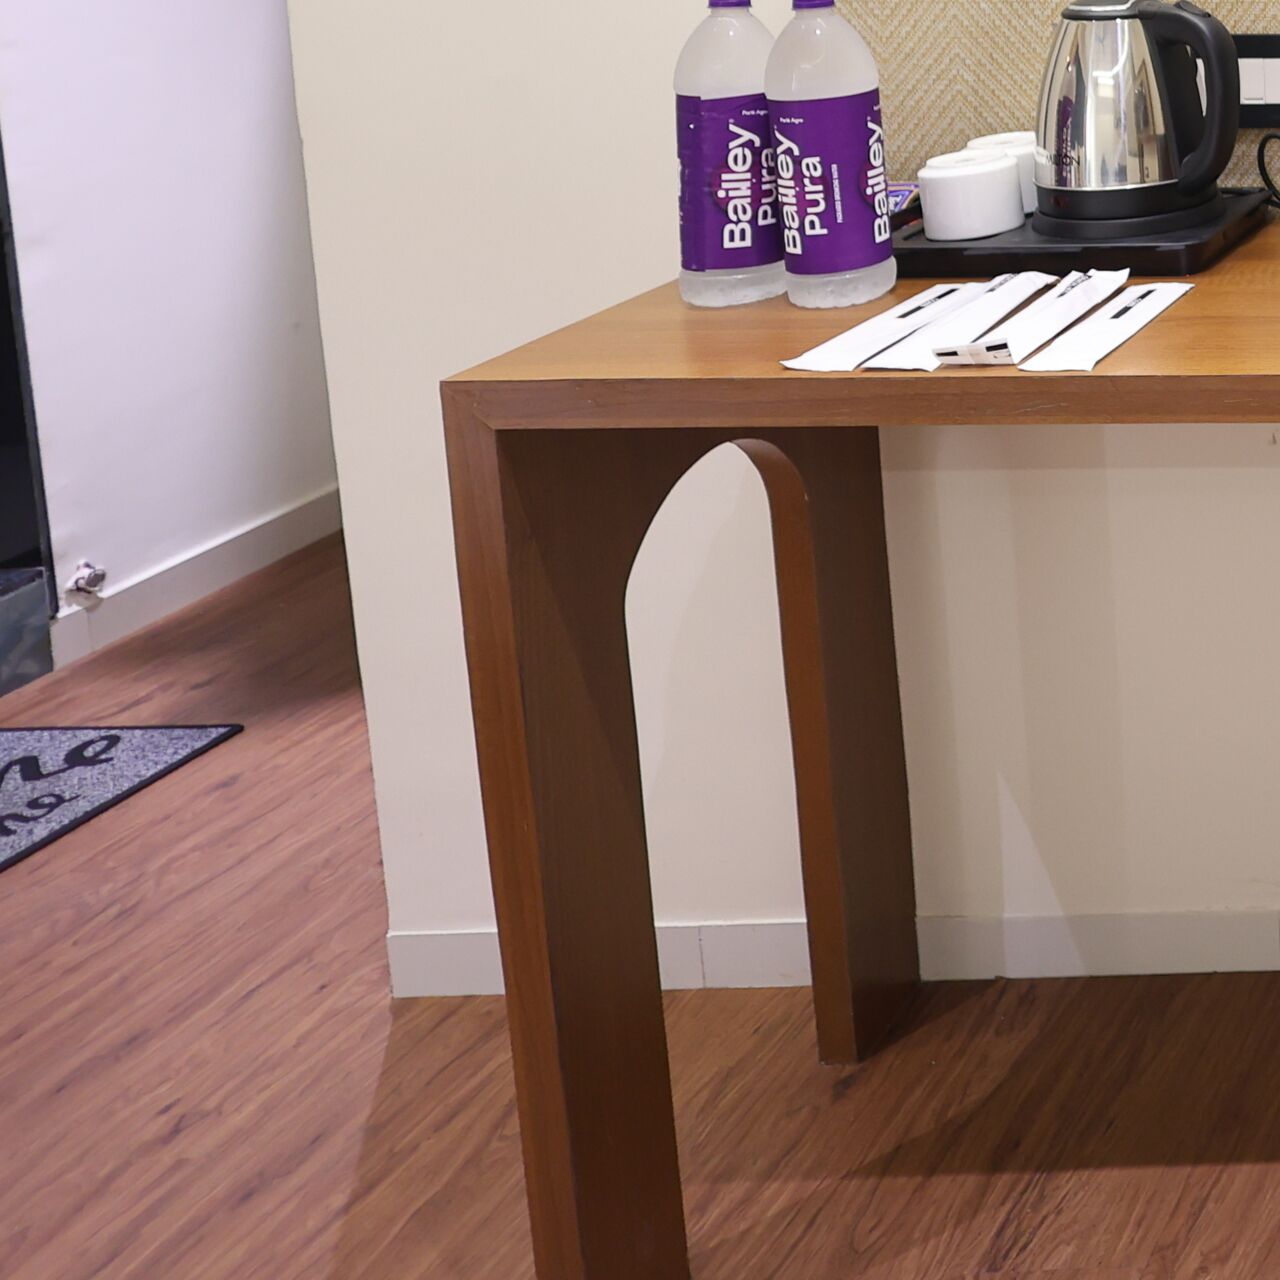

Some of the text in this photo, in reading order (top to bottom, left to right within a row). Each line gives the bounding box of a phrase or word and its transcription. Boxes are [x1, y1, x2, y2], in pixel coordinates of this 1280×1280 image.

[718, 122, 761, 249] Bailley
[758, 147, 777, 227] Pura
[774, 129, 803, 255] Bailley
[802, 156, 828, 237] Pura
[866, 121, 892, 243] Bailley
